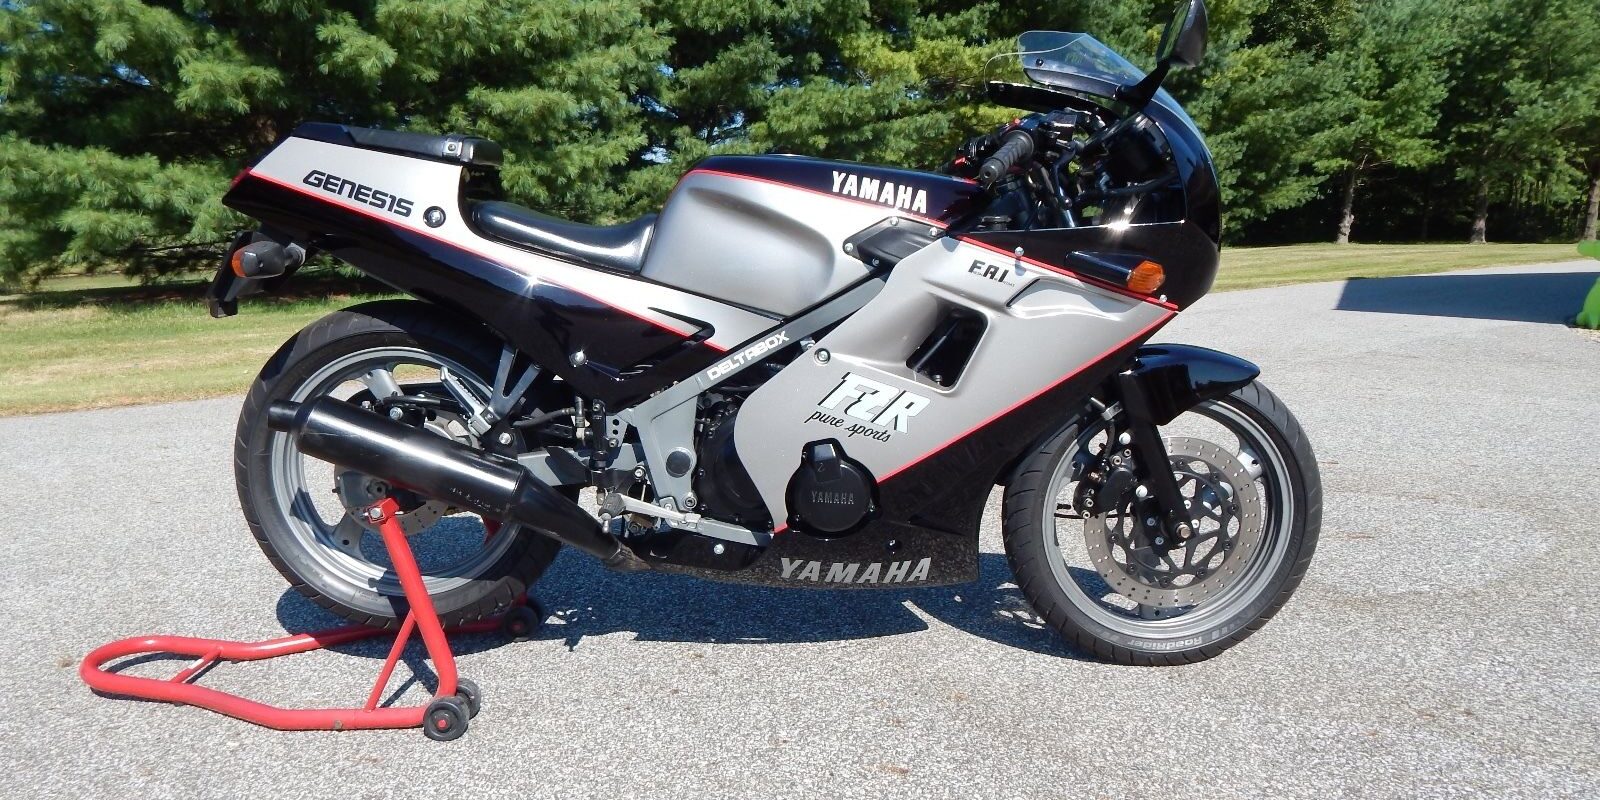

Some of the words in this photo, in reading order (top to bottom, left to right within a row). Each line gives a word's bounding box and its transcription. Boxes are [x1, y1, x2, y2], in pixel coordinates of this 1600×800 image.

[303, 169, 414, 217] GENESIS
[832, 171, 927, 214] YAMAHA
[706, 331, 790, 380] DELTABOX
[817, 372, 931, 434] FZR
[804, 411, 844, 427] pure
[844, 423, 891, 442] sports
[811, 491, 855, 505] YAMAHA
[780, 557, 932, 584] YAMAHA
[1127, 636, 1203, 650] RoadRider
